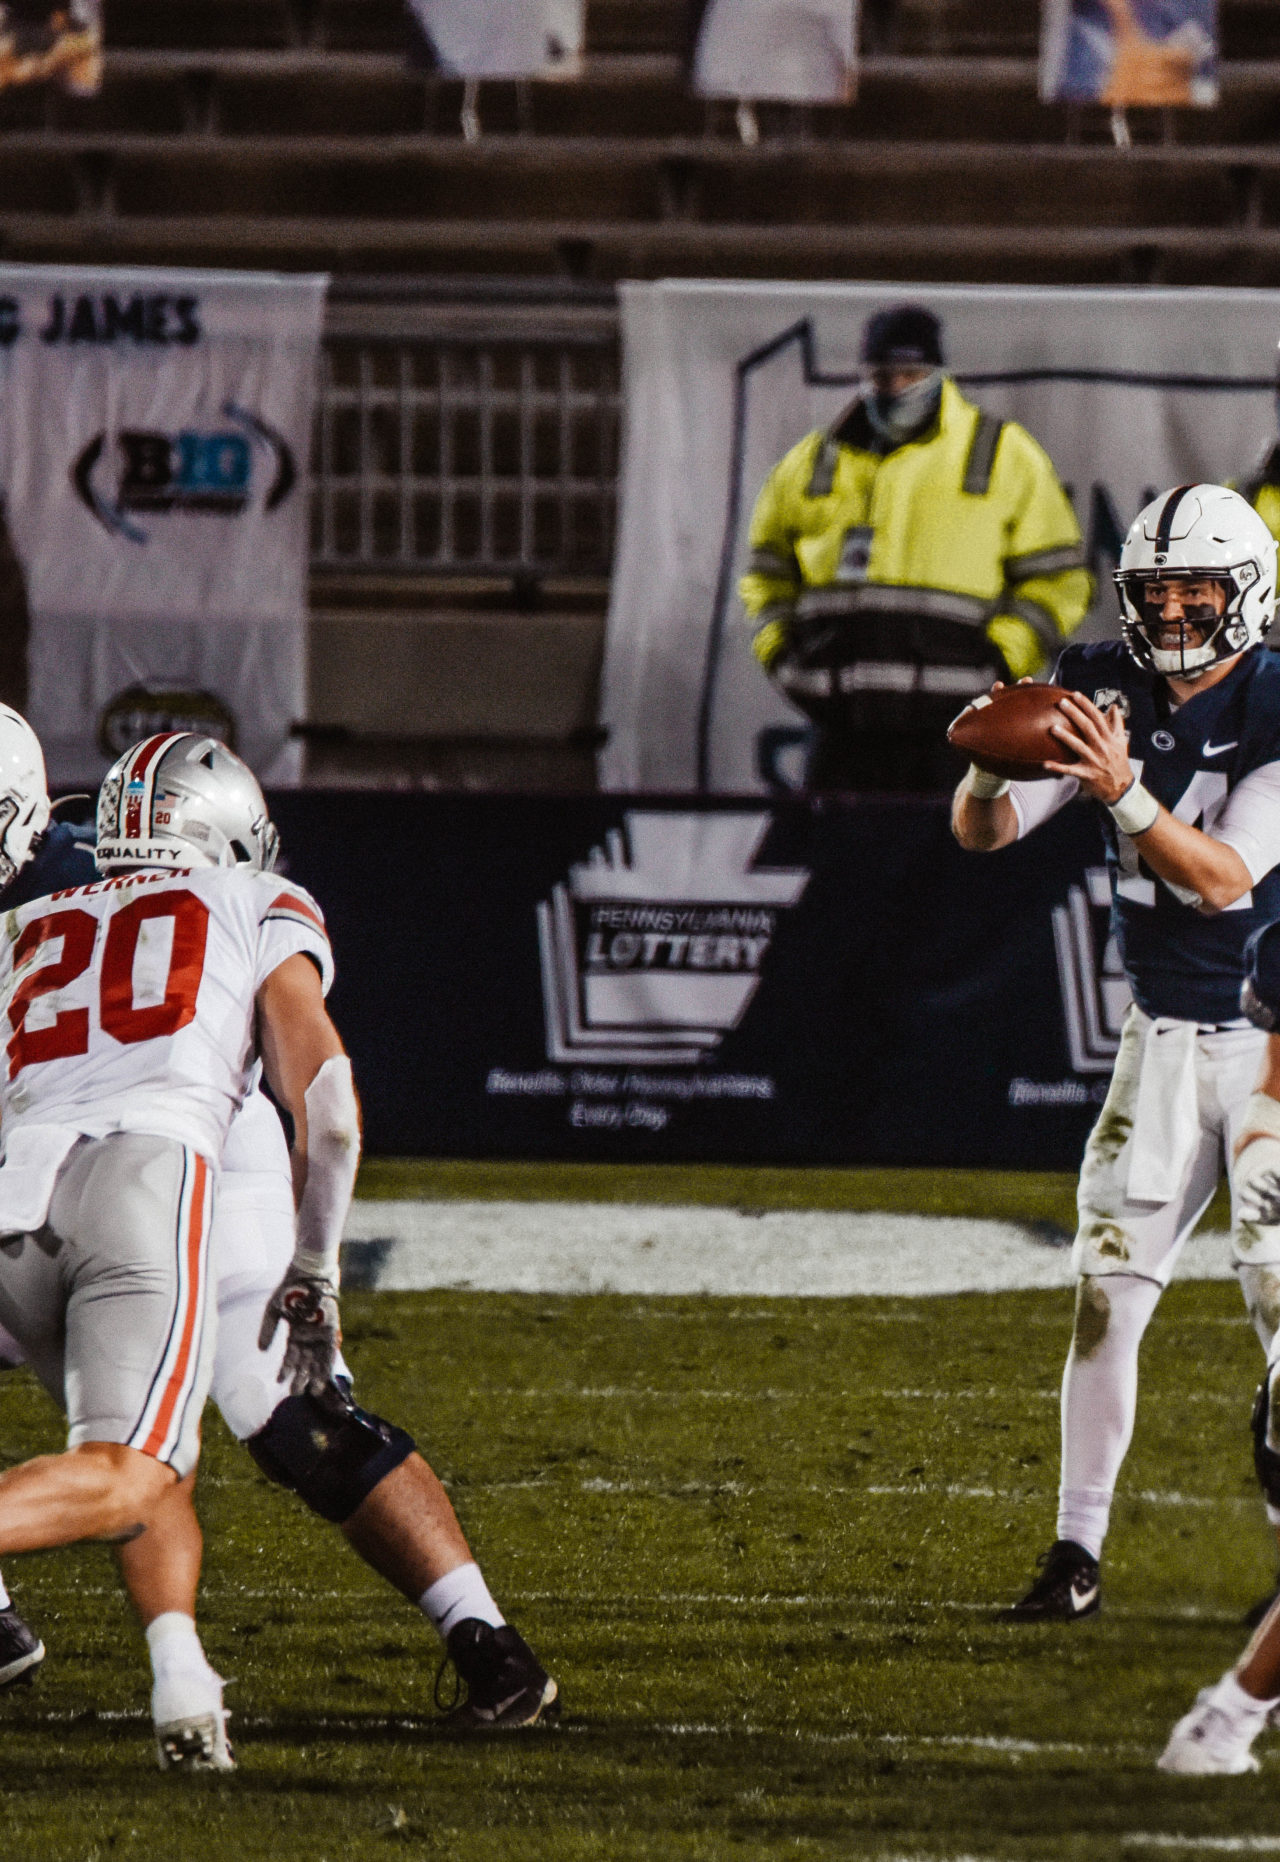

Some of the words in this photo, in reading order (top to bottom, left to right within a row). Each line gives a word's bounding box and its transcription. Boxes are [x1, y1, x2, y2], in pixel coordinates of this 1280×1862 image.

[39, 290, 201, 346] JAMES
[154, 811, 172, 825] 20
[585, 932, 771, 968] LOTTERY
[6, 888, 211, 1082] 20
